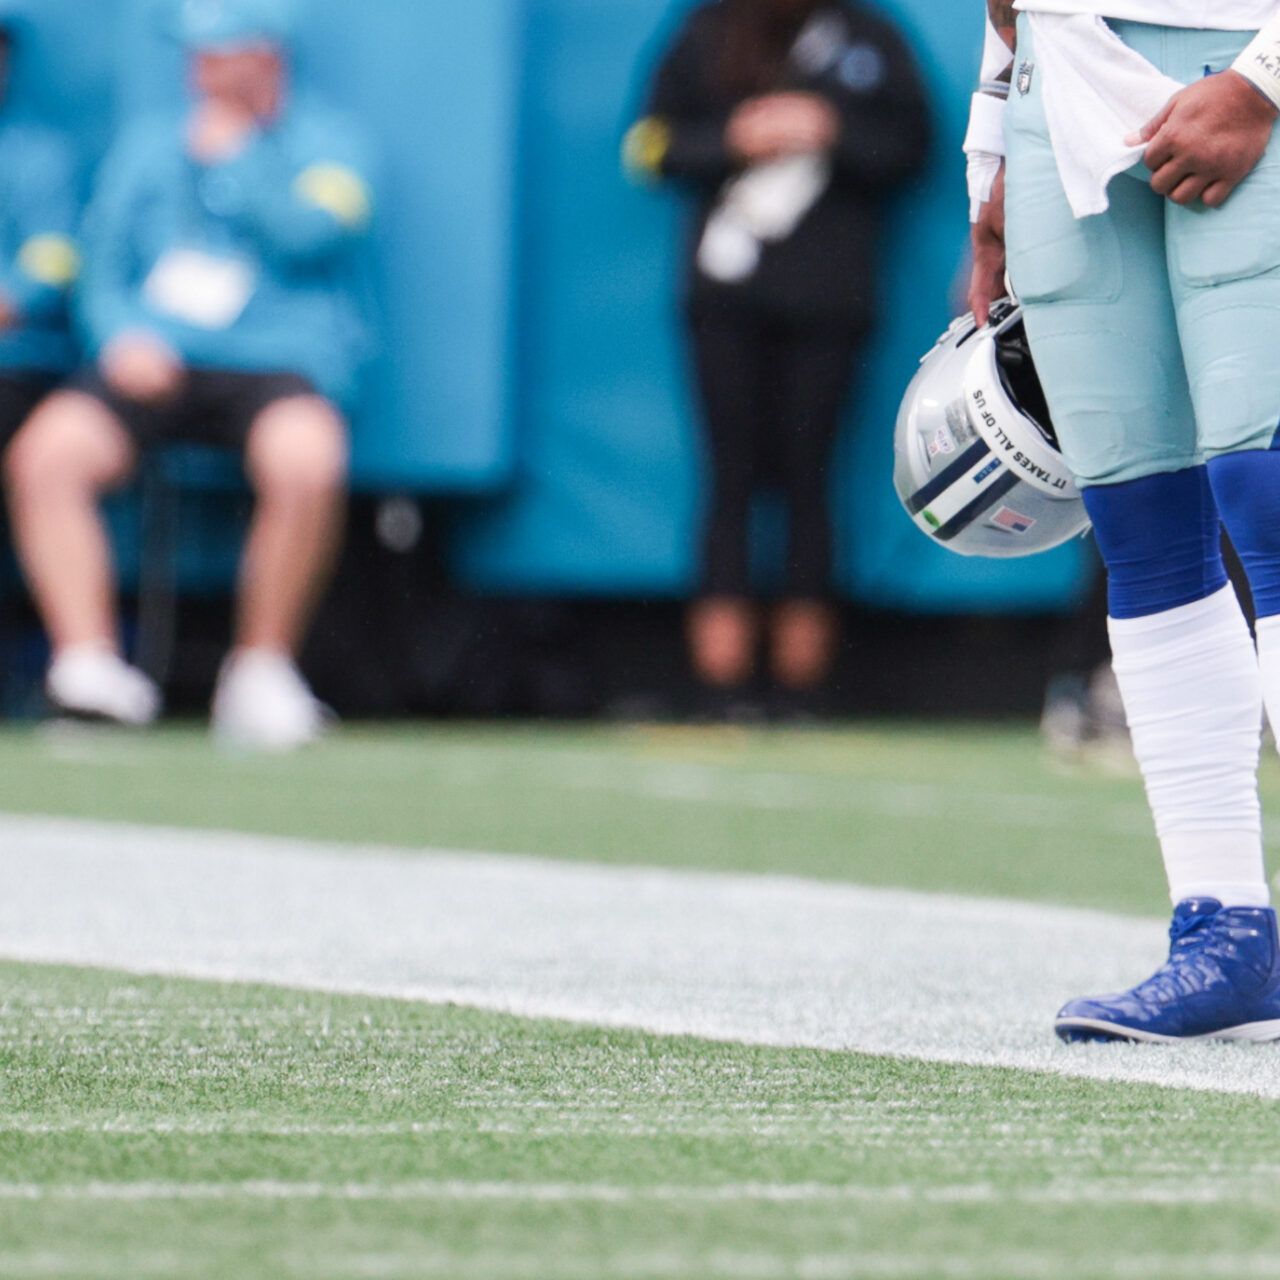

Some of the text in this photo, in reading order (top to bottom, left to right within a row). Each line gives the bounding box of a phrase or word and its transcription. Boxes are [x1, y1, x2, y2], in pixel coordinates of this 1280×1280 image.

[973, 389, 1066, 490] IT TAKES ALL OF US
